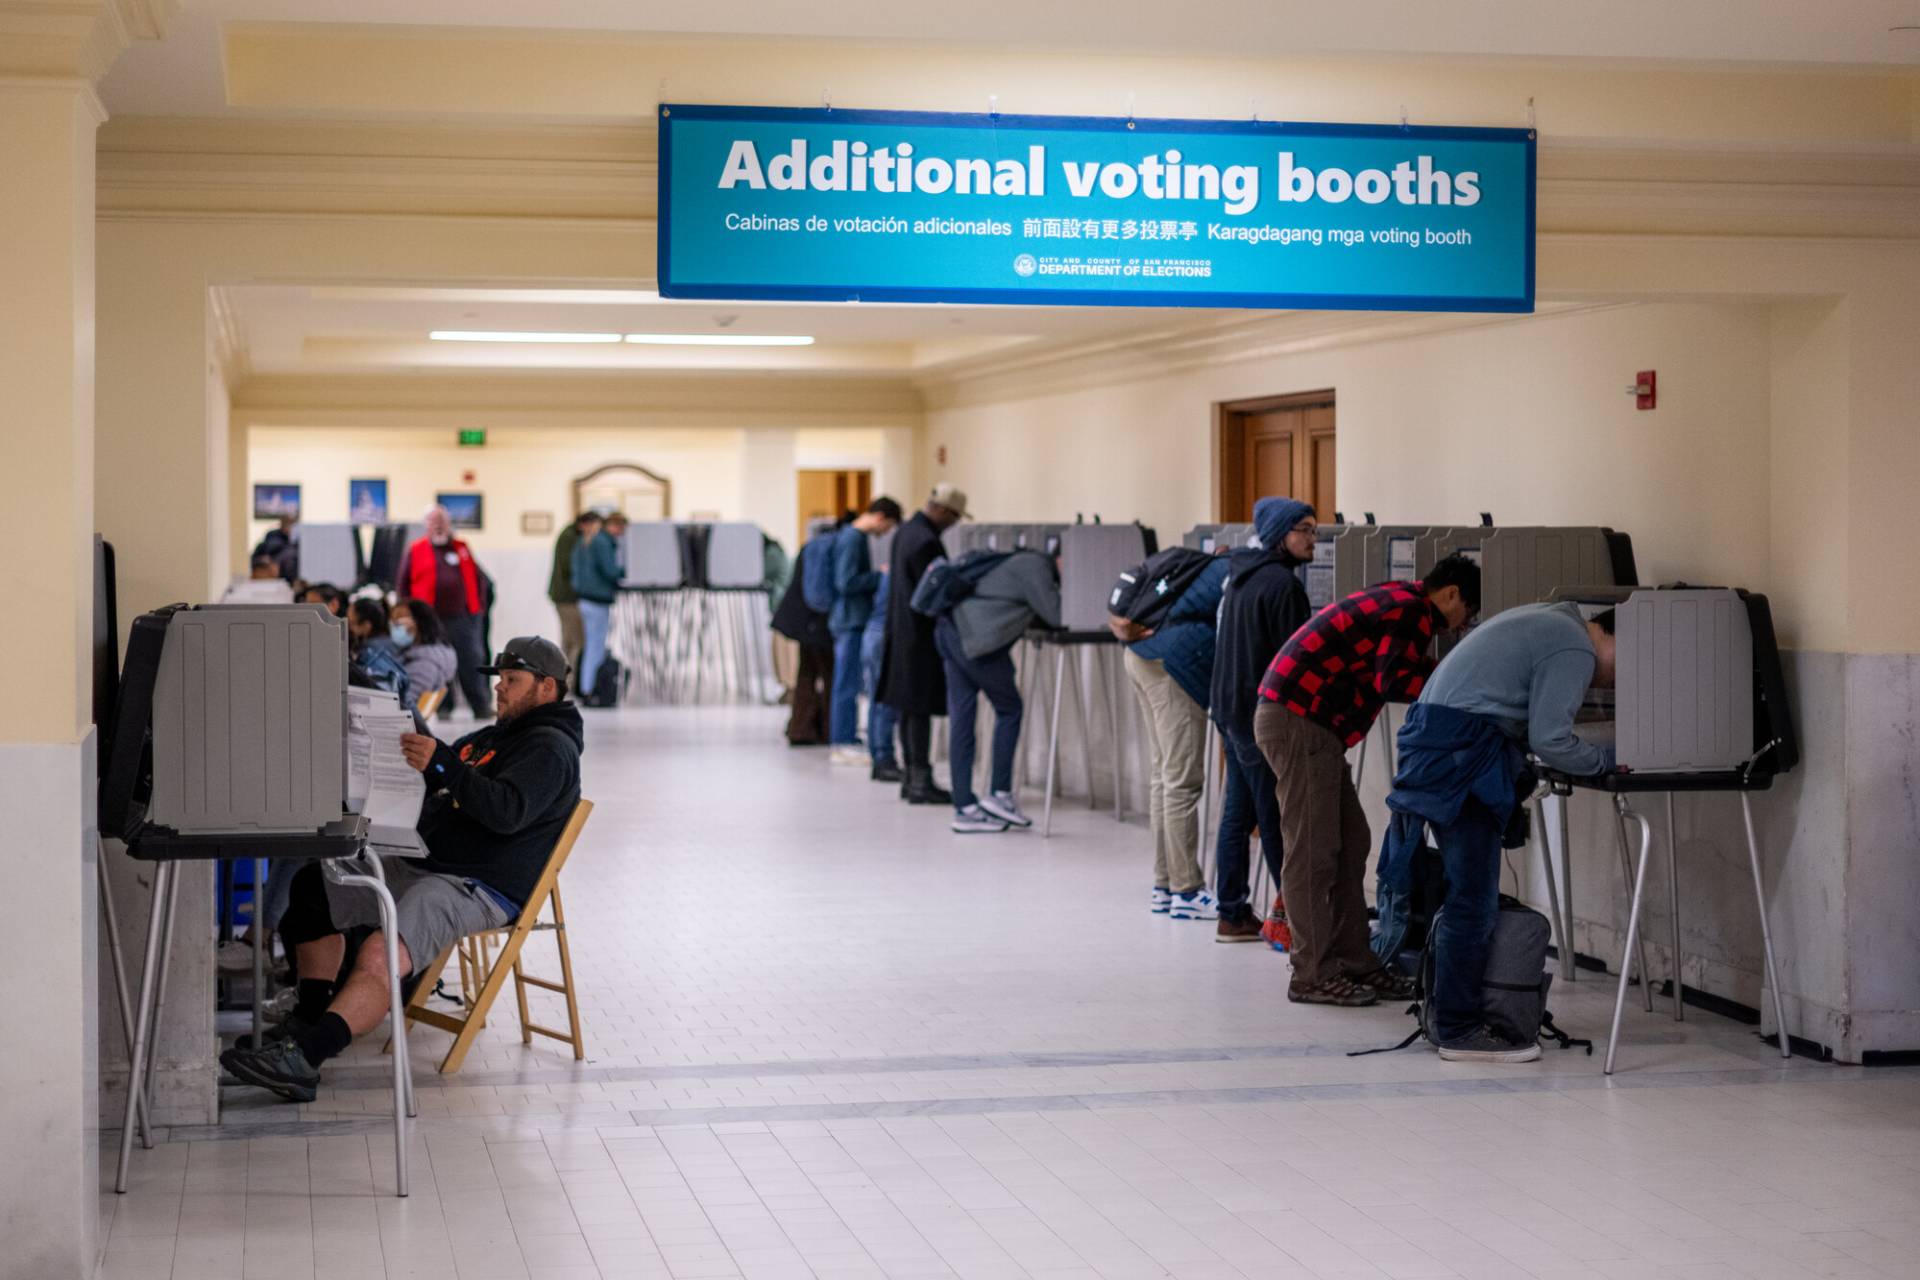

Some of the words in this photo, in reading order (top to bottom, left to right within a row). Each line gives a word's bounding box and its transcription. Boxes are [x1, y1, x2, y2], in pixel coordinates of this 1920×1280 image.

[718, 139, 1045, 197] Additional
[1062, 149, 1259, 216] voting
[1278, 151, 1481, 207] booths
[725, 213, 800, 232] Cabinas
[805, 215, 828, 232] de
[833, 215, 908, 234] votación
[913, 217, 1013, 236] adicionales
[1022, 217, 1199, 241] 前面設有更多投票亭
[1207, 223, 1323, 247] Karagdagang
[1328, 229, 1365, 247] mga
[1370, 228, 1420, 248] voting
[1425, 228, 1472, 245] booth
[1038, 264, 1122, 276] DEPARTMENT
[1123, 265, 1141, 277] OF
[1142, 265, 1212, 278] ELECTIONS
